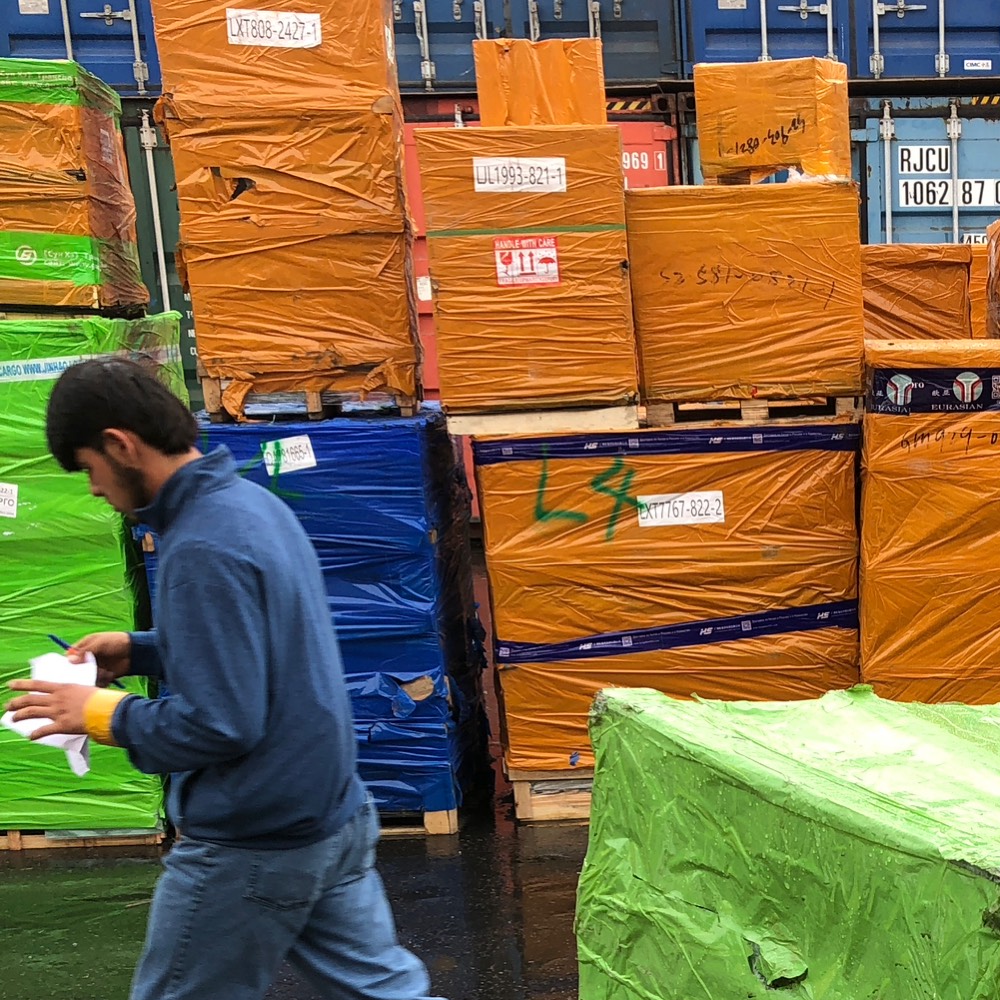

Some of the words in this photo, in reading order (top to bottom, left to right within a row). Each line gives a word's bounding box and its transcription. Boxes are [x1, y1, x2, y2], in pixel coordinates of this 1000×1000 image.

[229, 17, 317, 41] LXT808-2427-1
[900, 147, 949, 172] RJCU
[902, 181, 949, 206] 1062
[962, 181, 985, 205] 87
[538, 238, 555, 248] CARE
[931, 403, 983, 411] EURASIAN
